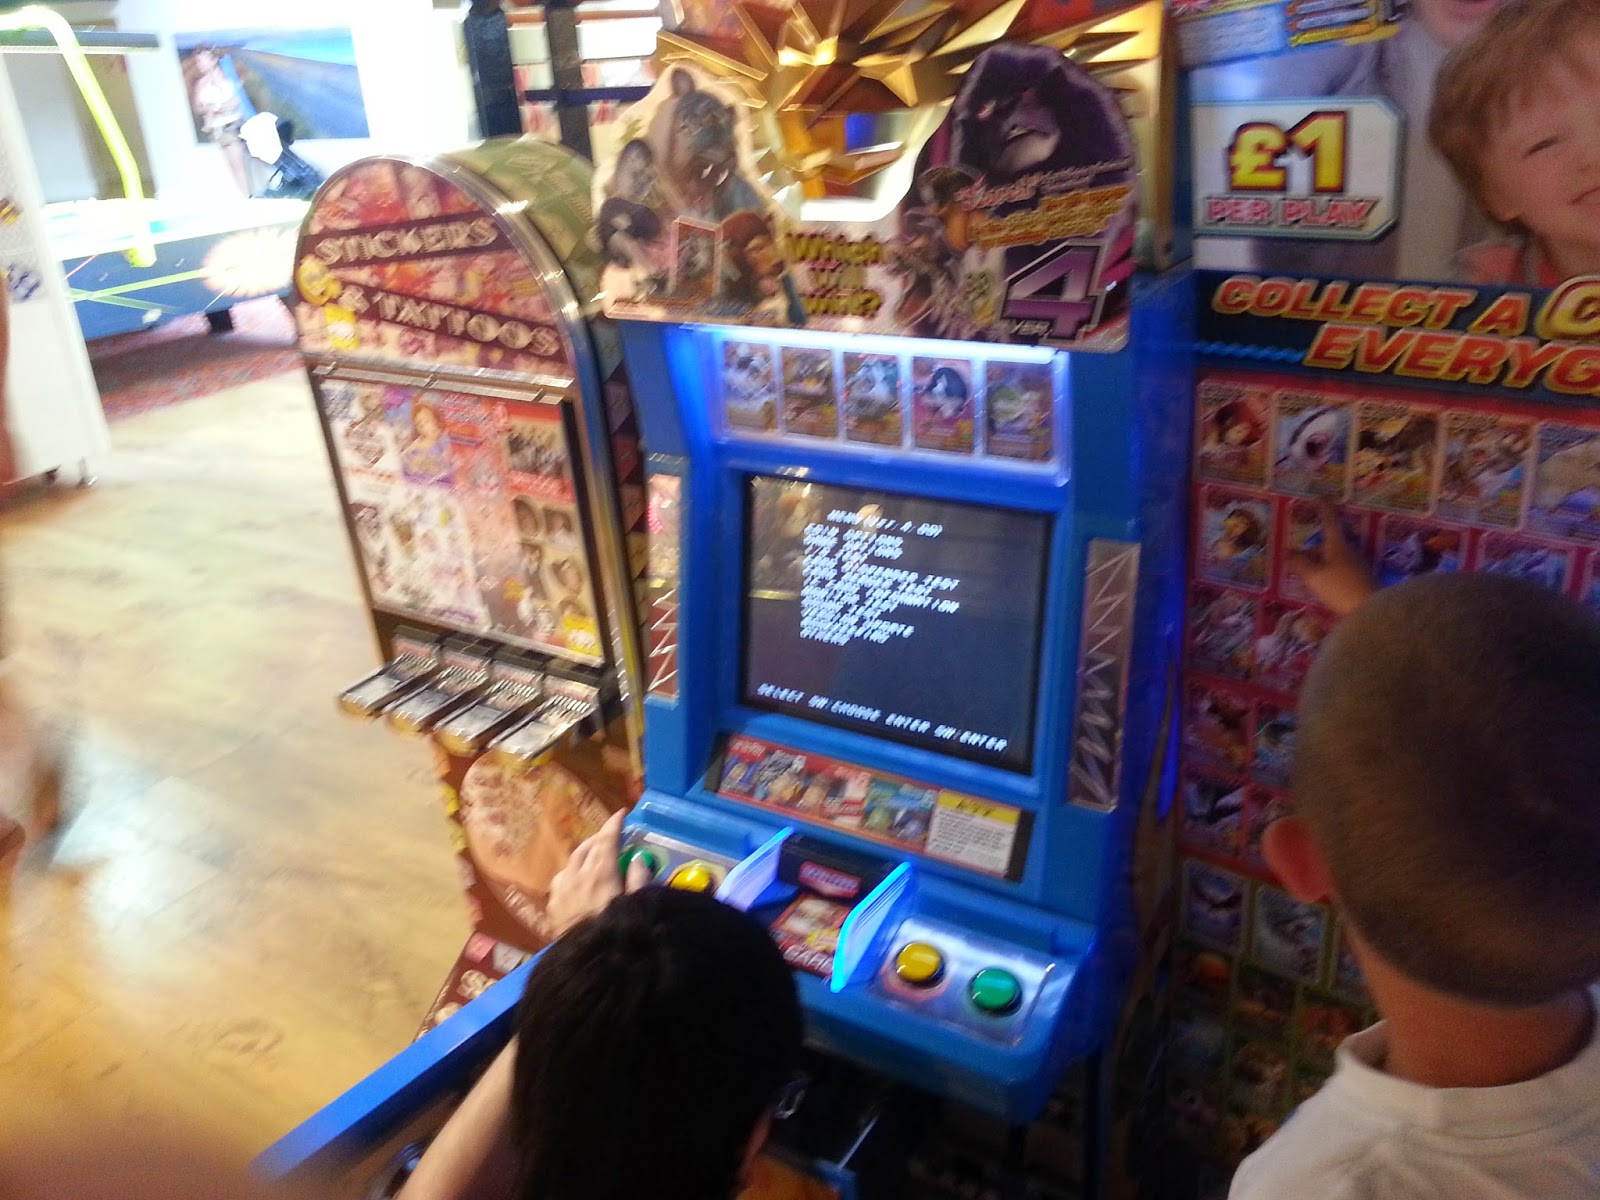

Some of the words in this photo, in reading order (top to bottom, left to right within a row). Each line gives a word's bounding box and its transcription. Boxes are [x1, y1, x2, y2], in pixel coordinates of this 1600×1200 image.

[1226, 110, 1348, 193] £1
[314, 217, 499, 265] STICKERS
[1205, 194, 1273, 225] PER
[1281, 197, 1378, 228] PLAY
[1001, 240, 1107, 341] 4
[1211, 275, 1478, 330] COLLECT
[1466, 291, 1531, 338] A
[373, 292, 561, 356] TATTOOS
[757, 683, 804, 703] SELECT
[885, 713, 931, 734] ENTER
